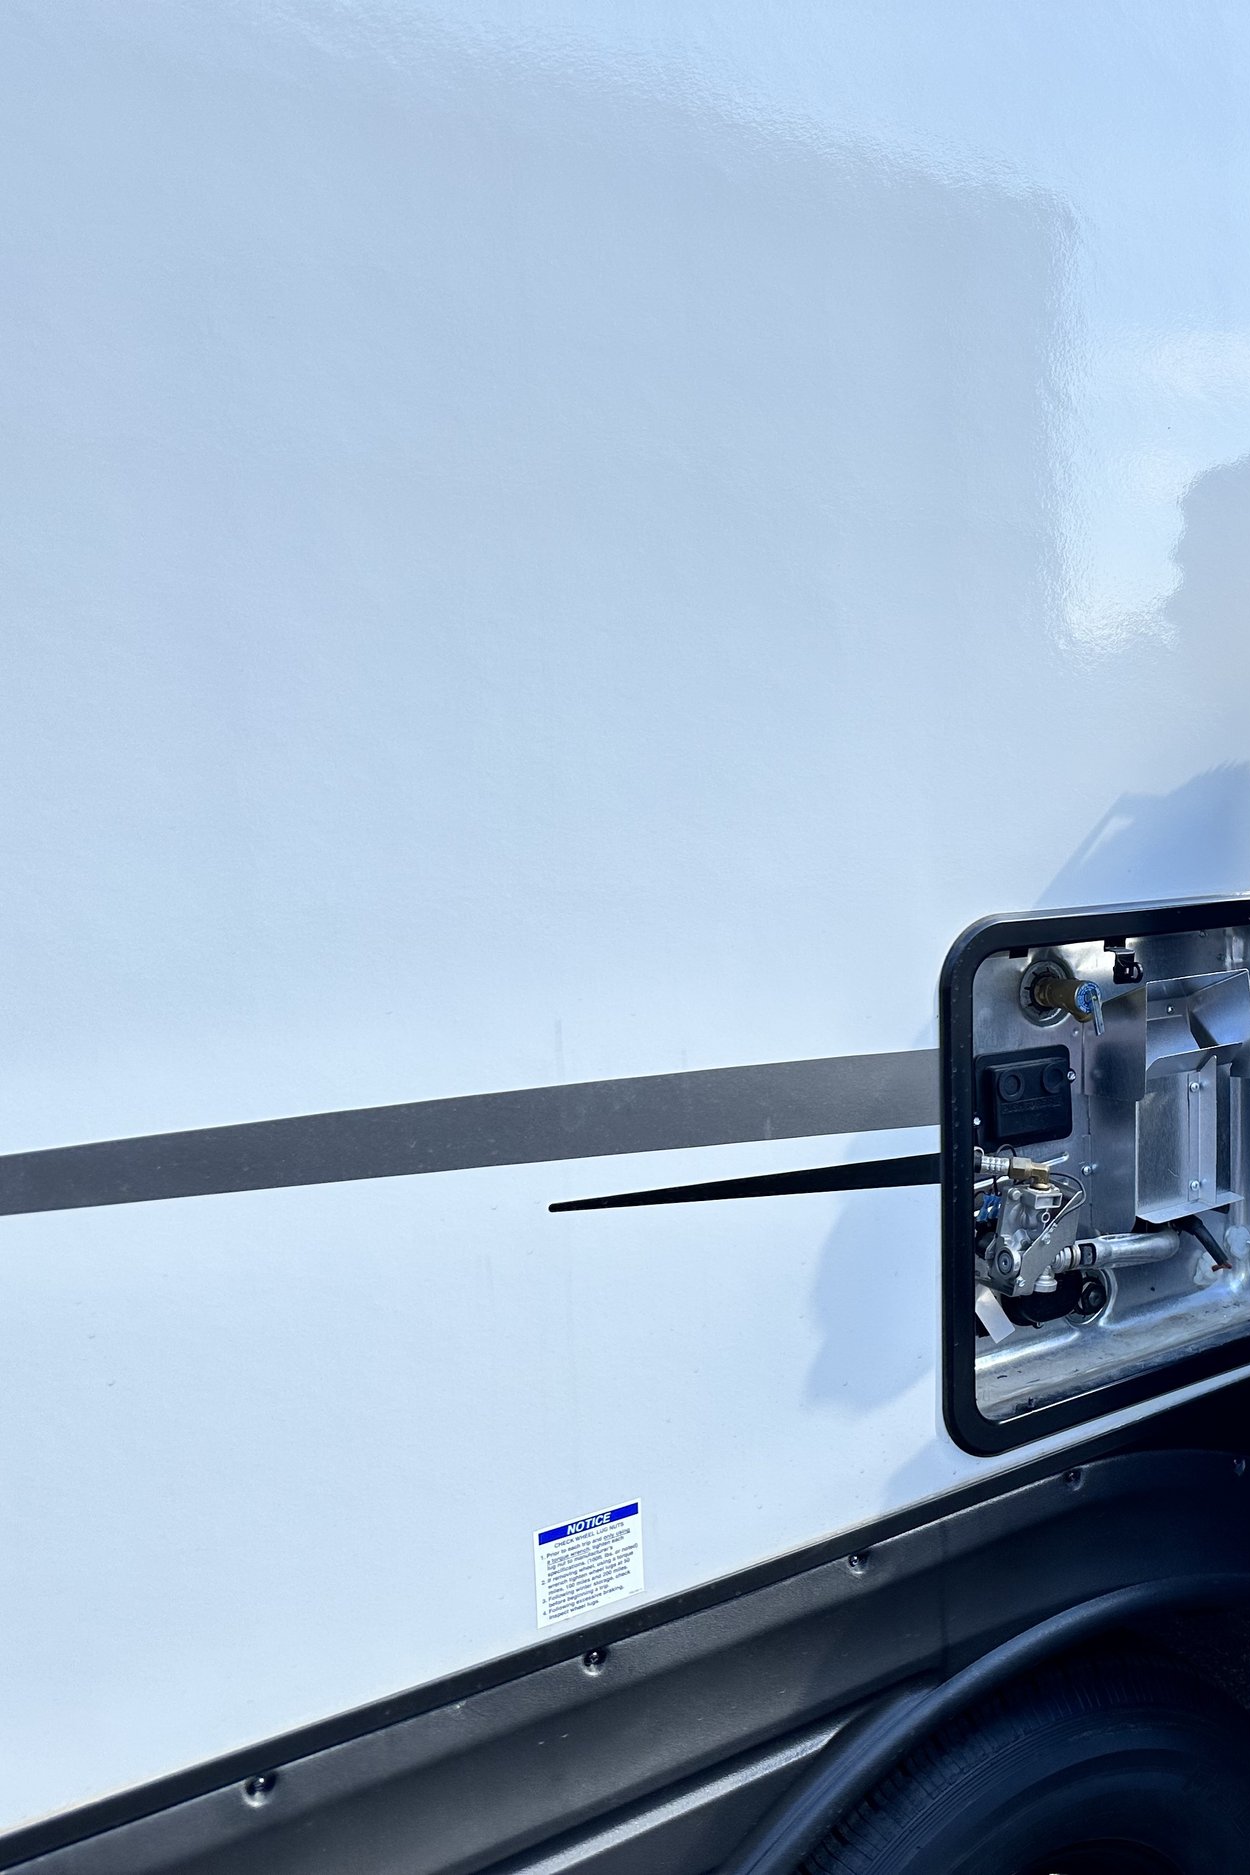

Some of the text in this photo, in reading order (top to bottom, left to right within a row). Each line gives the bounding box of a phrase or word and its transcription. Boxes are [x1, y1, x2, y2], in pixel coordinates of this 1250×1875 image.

[567, 1512, 612, 1535] NOTICE
[554, 1521, 624, 1549] CHECK WHEEL LUG NUTS
[612, 1535, 624, 1543] each
[547, 1550, 559, 1558] Prior
[568, 1543, 580, 1551] each
[582, 1540, 591, 1548] trip
[576, 1577, 590, 1586] miles
